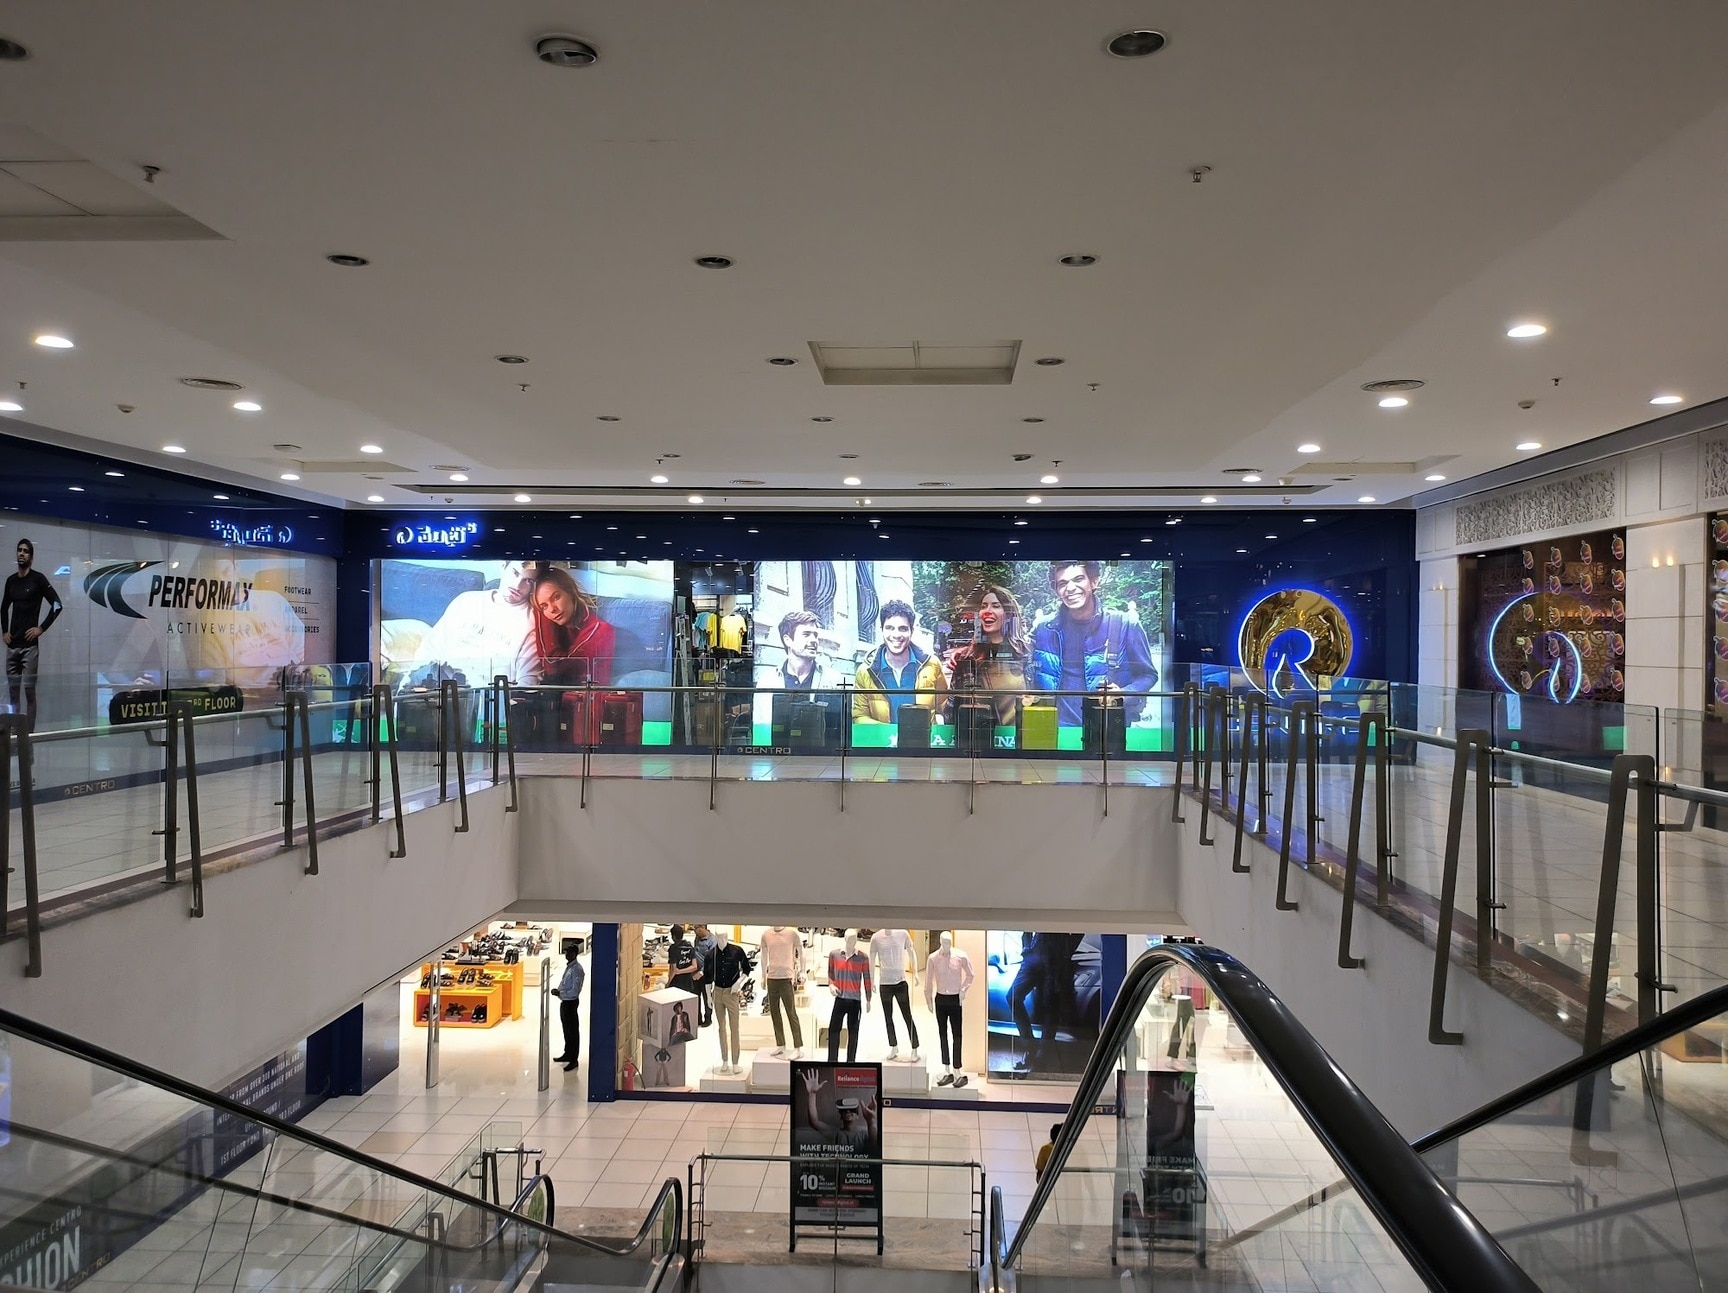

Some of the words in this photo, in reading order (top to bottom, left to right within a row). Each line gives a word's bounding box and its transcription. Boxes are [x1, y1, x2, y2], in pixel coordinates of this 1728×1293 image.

[148, 574, 253, 611] PERFORMAX
[284, 585, 312, 596] FOOTWEAR
[166, 622, 252, 636] ACTIVEWEAR
[284, 624, 320, 634] ACCEORIES
[121, 702, 158, 718] VISIT
[204, 696, 236, 711] FLOOR
[745, 747, 791, 755] CENTRO
[72, 780, 116, 796] CENTRO
[236, 1083, 249, 1099] FROM
[250, 1076, 262, 1091] OVER
[271, 1059, 291, 1076] NATIONAL
[253, 1084, 270, 1102] BRANDS
[271, 1074, 285, 1090] UNDER
[285, 1067, 294, 1081] ONE
[294, 1060, 305, 1074] ROOF
[837, 1074, 860, 1082] Reliance
[221, 1150, 230, 1166] 1ST
[287, 1099, 301, 1117] FLOOR
[800, 1144, 821, 1152] MAKE
[822, 1145, 855, 1153] FRIENDS
[0, 1229, 46, 1269] XPERIENCE
[50, 1204, 82, 1235] CENTRO
[1, 1225, 80, 1290] HION
